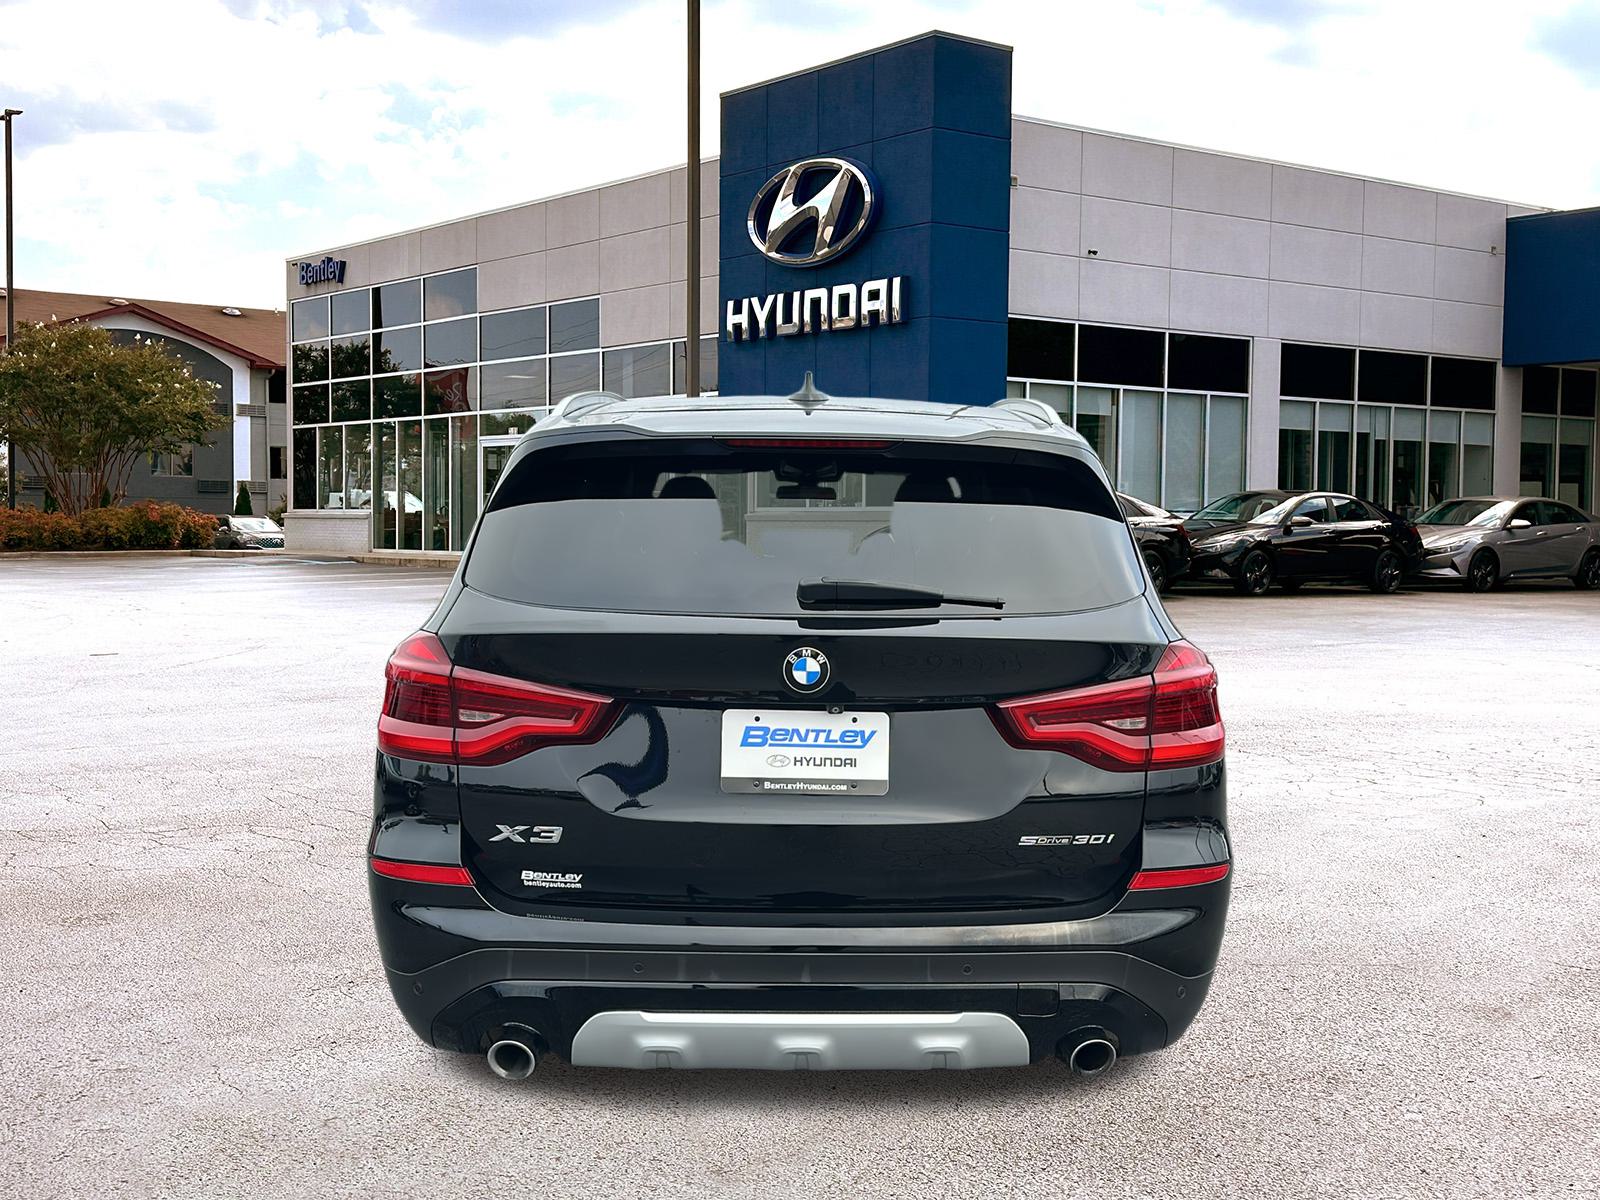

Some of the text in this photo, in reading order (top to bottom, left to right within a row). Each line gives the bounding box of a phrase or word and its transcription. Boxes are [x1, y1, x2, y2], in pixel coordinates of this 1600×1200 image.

[299, 257, 345, 285] Bentley
[726, 276, 902, 342] HYUNDAI
[788, 648, 826, 664] BMW
[739, 725, 877, 749] BENTLEY
[793, 756, 857, 768] HYUNDAI
[488, 824, 564, 844] X3
[523, 880, 582, 889] bentleyauto.com
